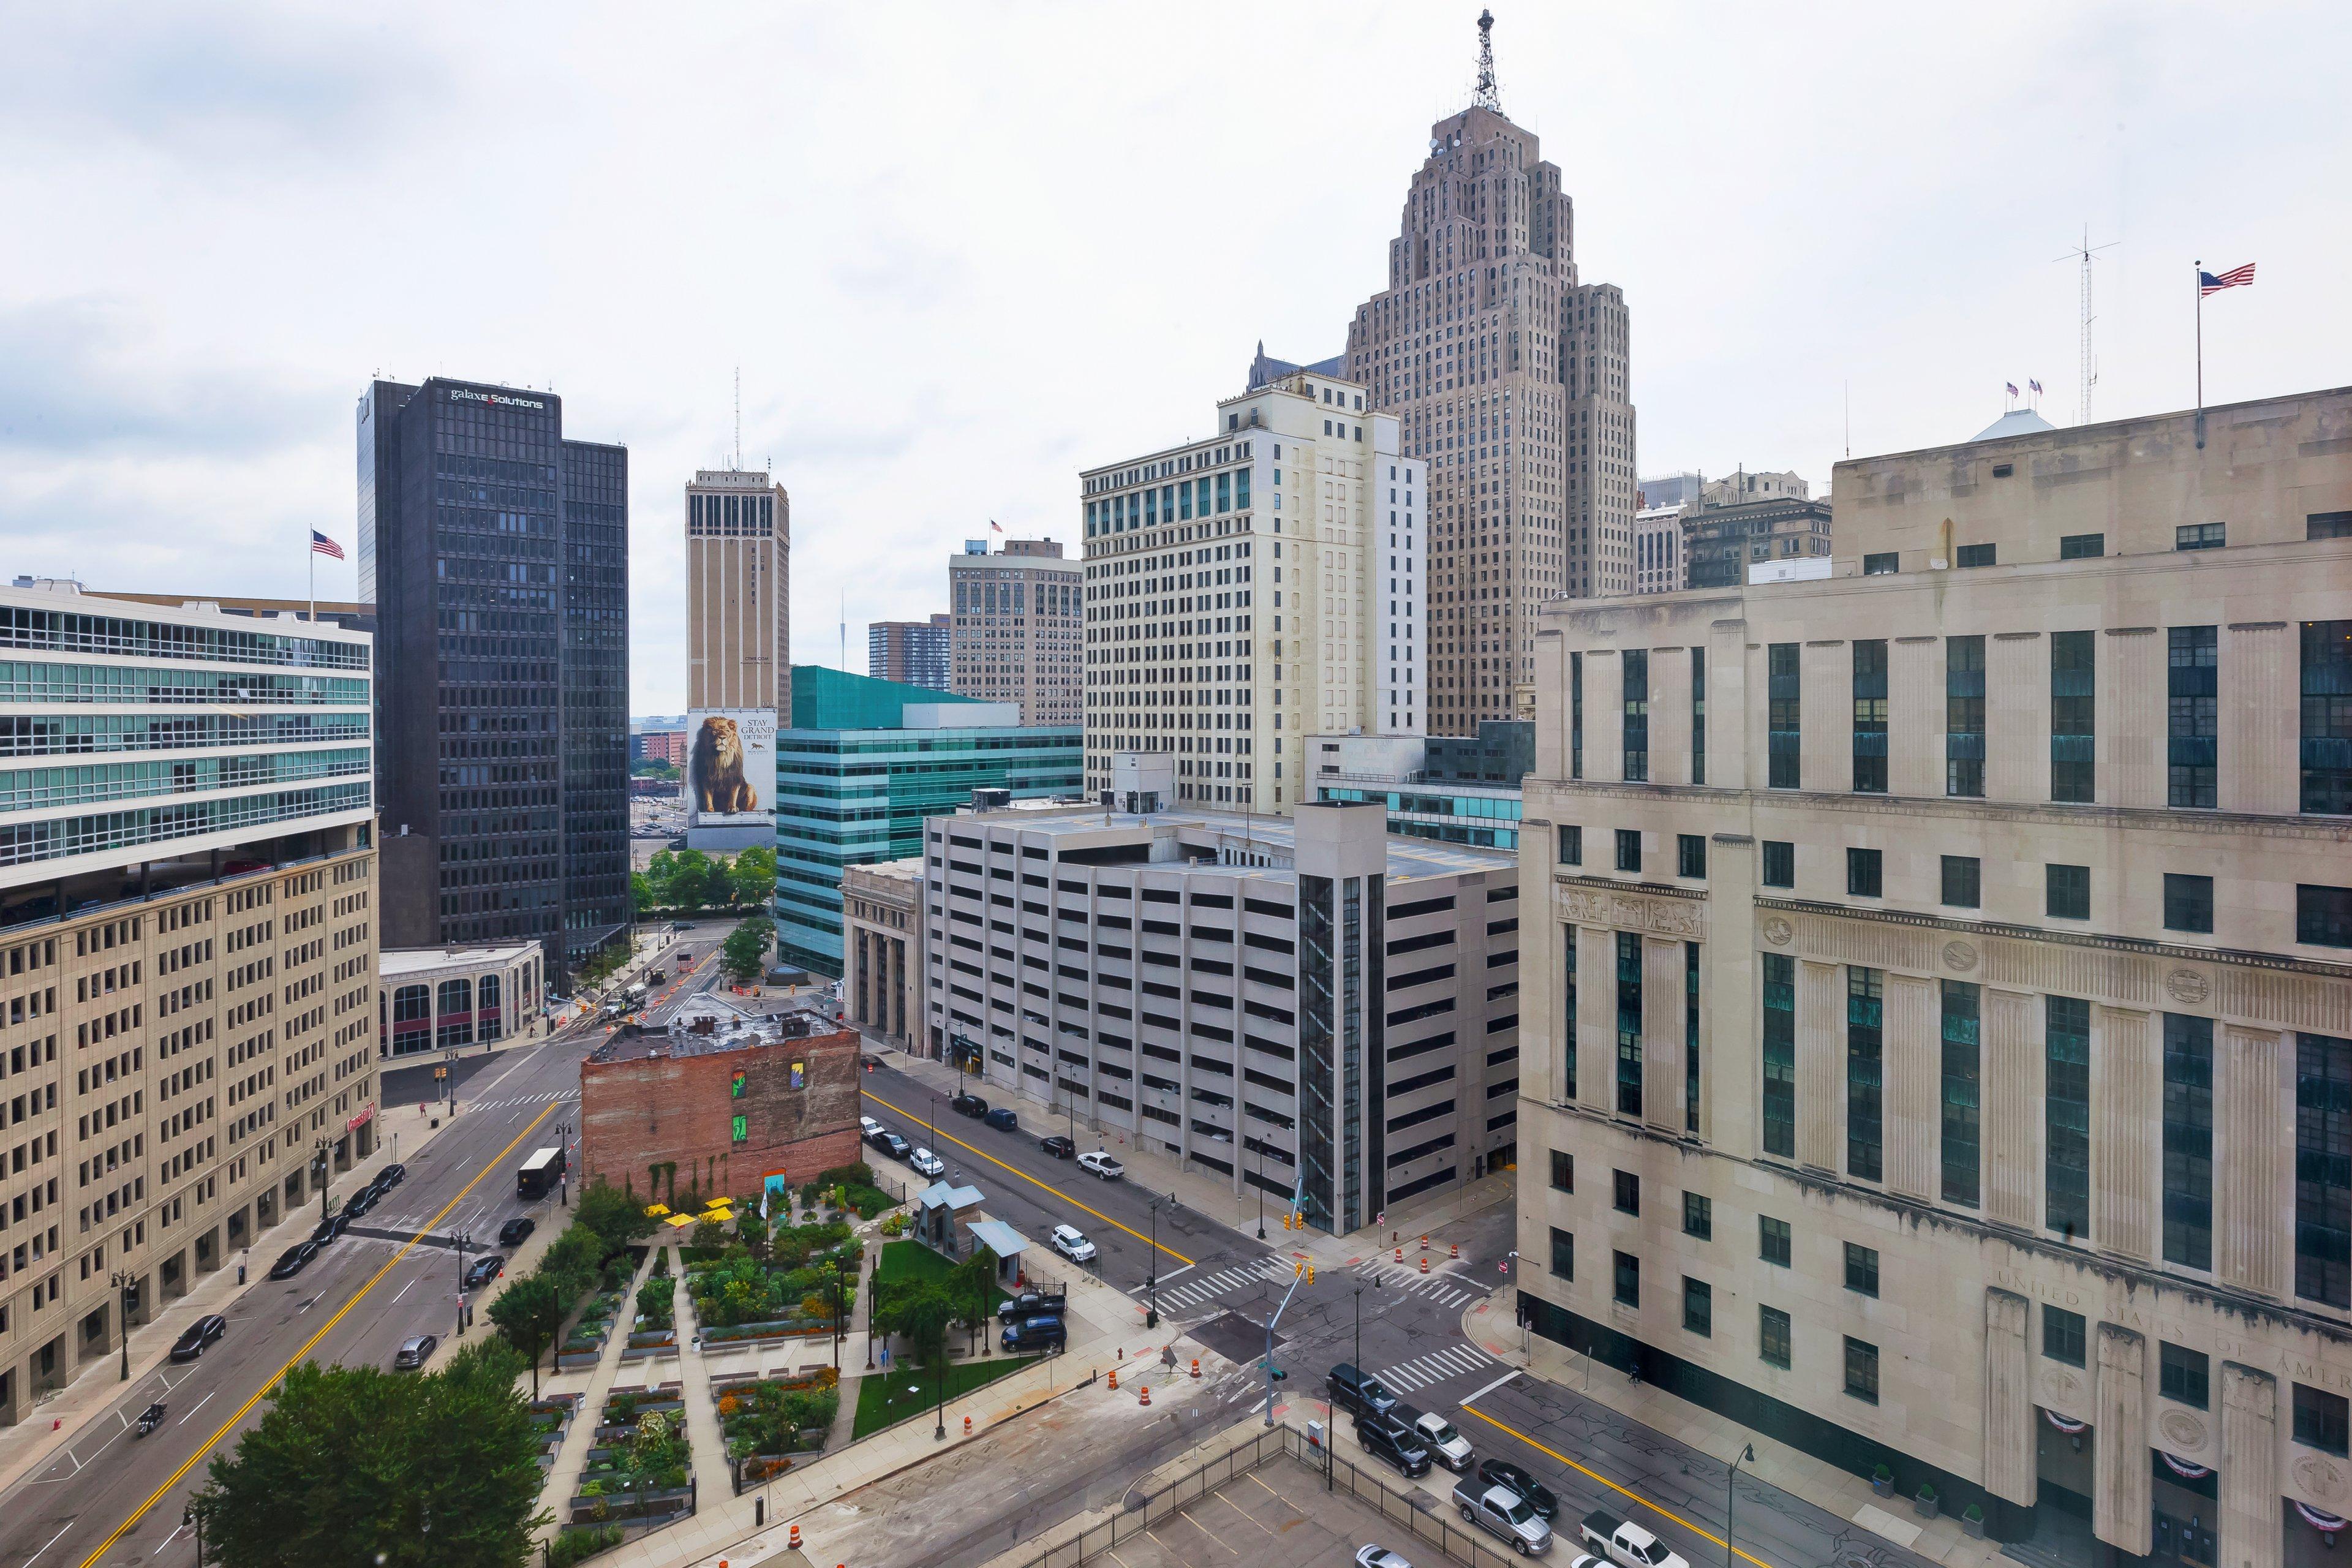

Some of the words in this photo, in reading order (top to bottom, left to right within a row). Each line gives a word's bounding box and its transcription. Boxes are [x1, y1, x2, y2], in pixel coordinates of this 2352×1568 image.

[467, 962, 497, 972] BANK
[1998, 1270, 2079, 1306] UNITED
[2104, 1303, 2184, 1339] STATES
[2214, 1336, 2248, 1357] OF
